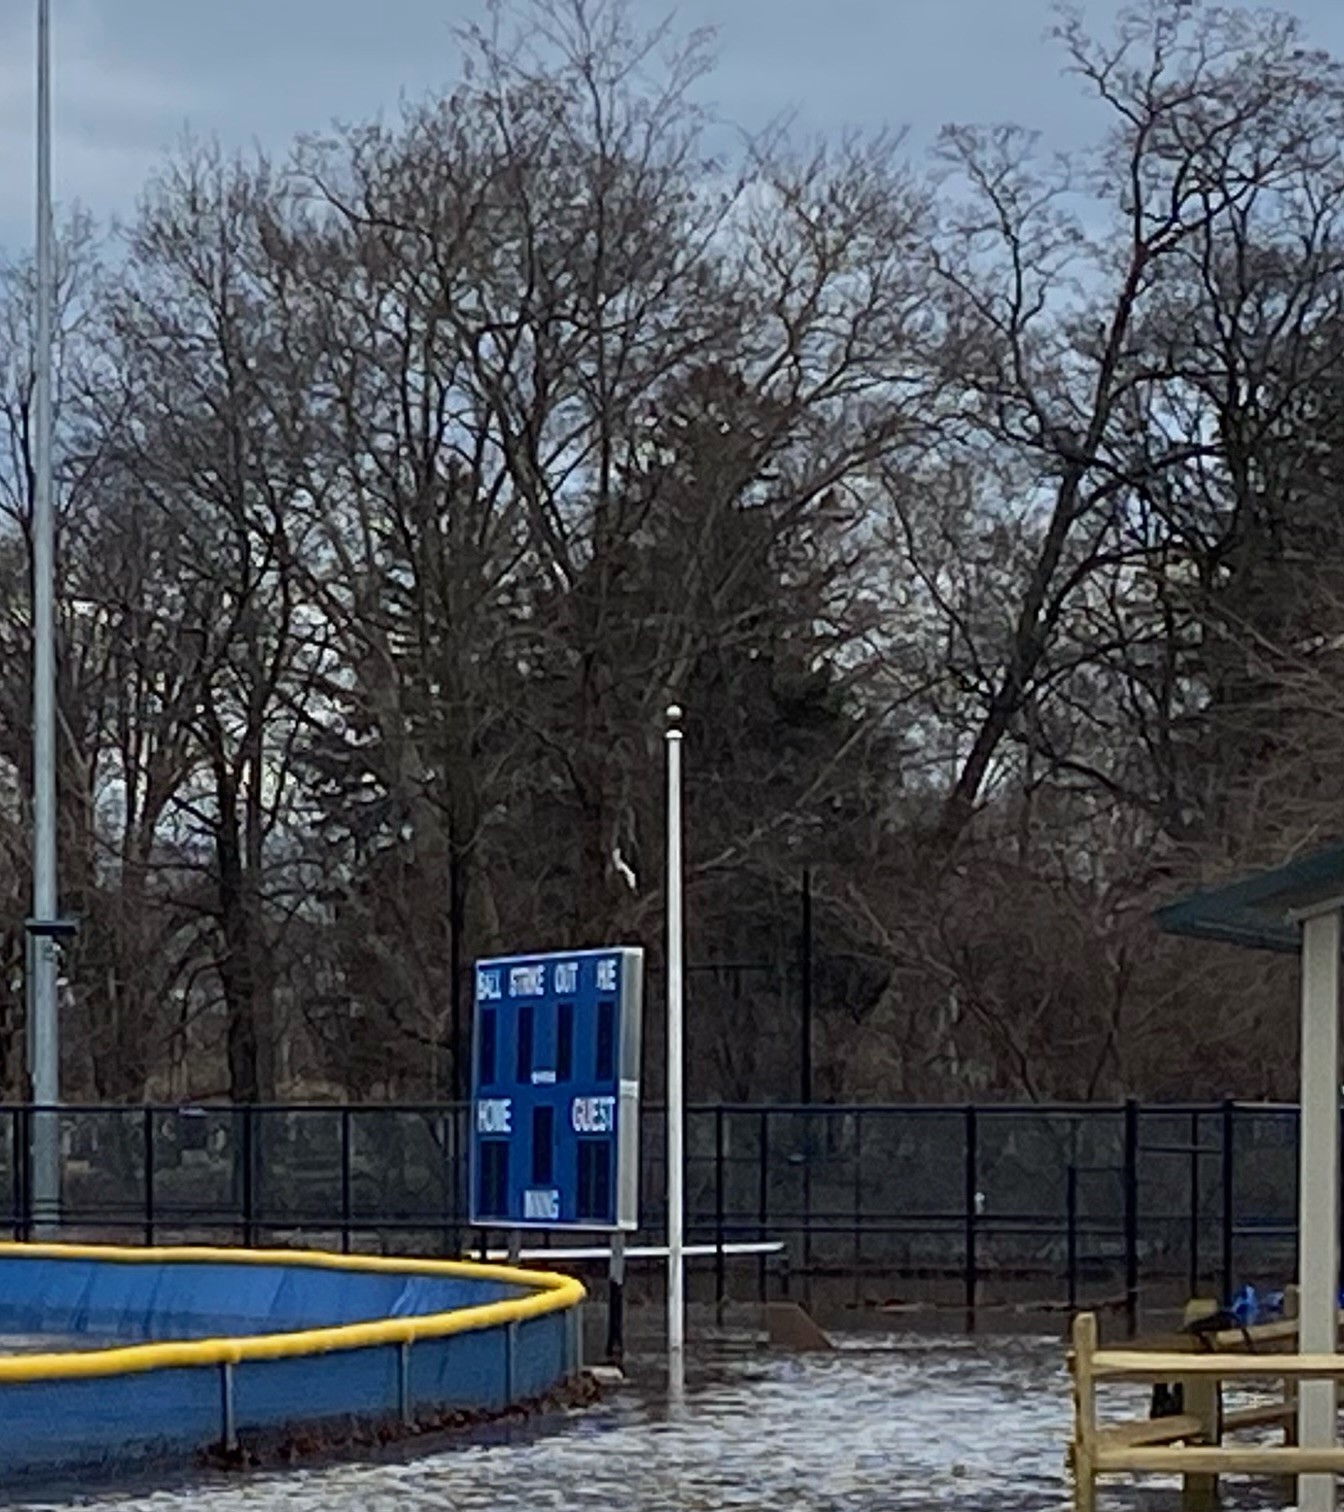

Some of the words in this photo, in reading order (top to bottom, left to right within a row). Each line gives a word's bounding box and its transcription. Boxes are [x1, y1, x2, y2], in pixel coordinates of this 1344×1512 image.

[477, 969, 502, 1000] BALL
[555, 962, 579, 994] OUT
[478, 1098, 512, 1133] HOME
[572, 1095, 616, 1132] GUEST
